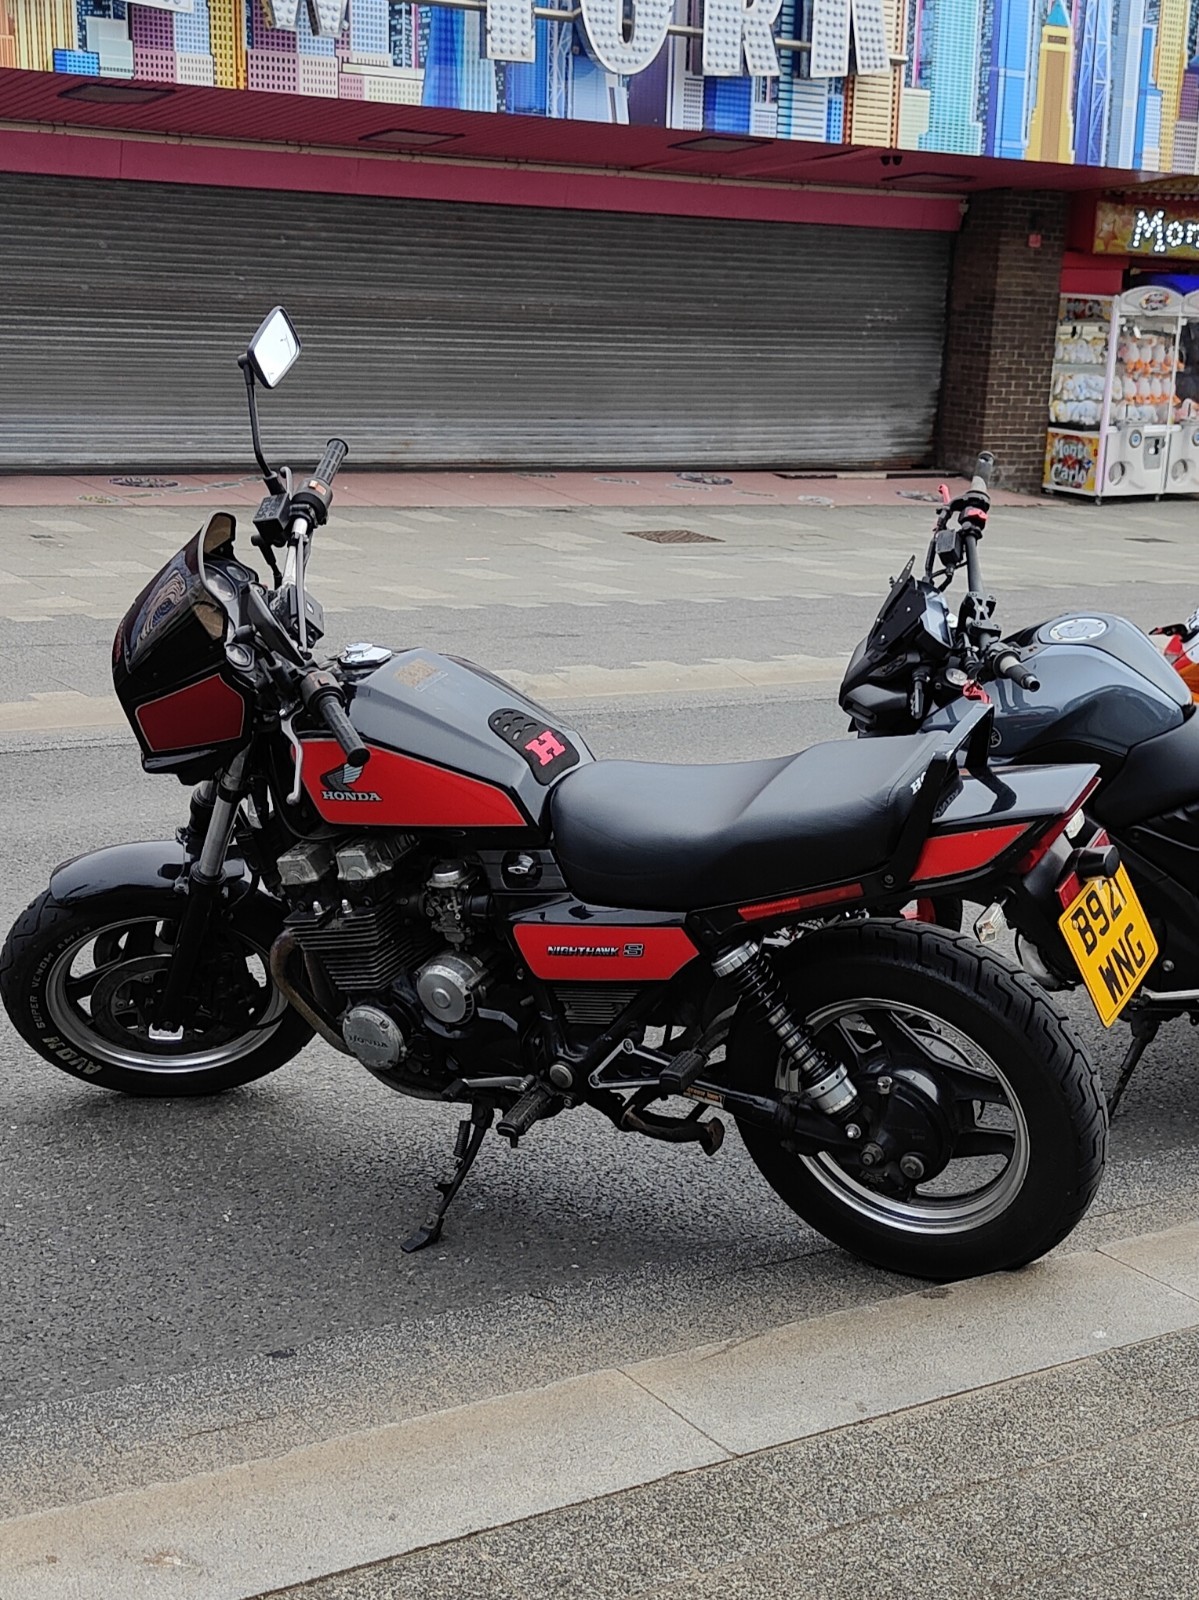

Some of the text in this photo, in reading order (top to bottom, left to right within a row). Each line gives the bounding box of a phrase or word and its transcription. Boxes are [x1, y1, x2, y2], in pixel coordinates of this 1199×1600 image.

[1052, 438, 1089, 459] Monte
[1050, 463, 1087, 483] Carlo
[524, 730, 566, 766] H
[321, 790, 383, 801] HONDA
[1071, 877, 1127, 957] B921
[547, 943, 645, 957] NIGHTHAWK S
[1098, 922, 1146, 1005] WNG
[31, 952, 54, 988] VENOM
[29, 995, 46, 1029] SUPER
[42, 1036, 103, 1075] AVON
[348, 1034, 389, 1049] HONDA
